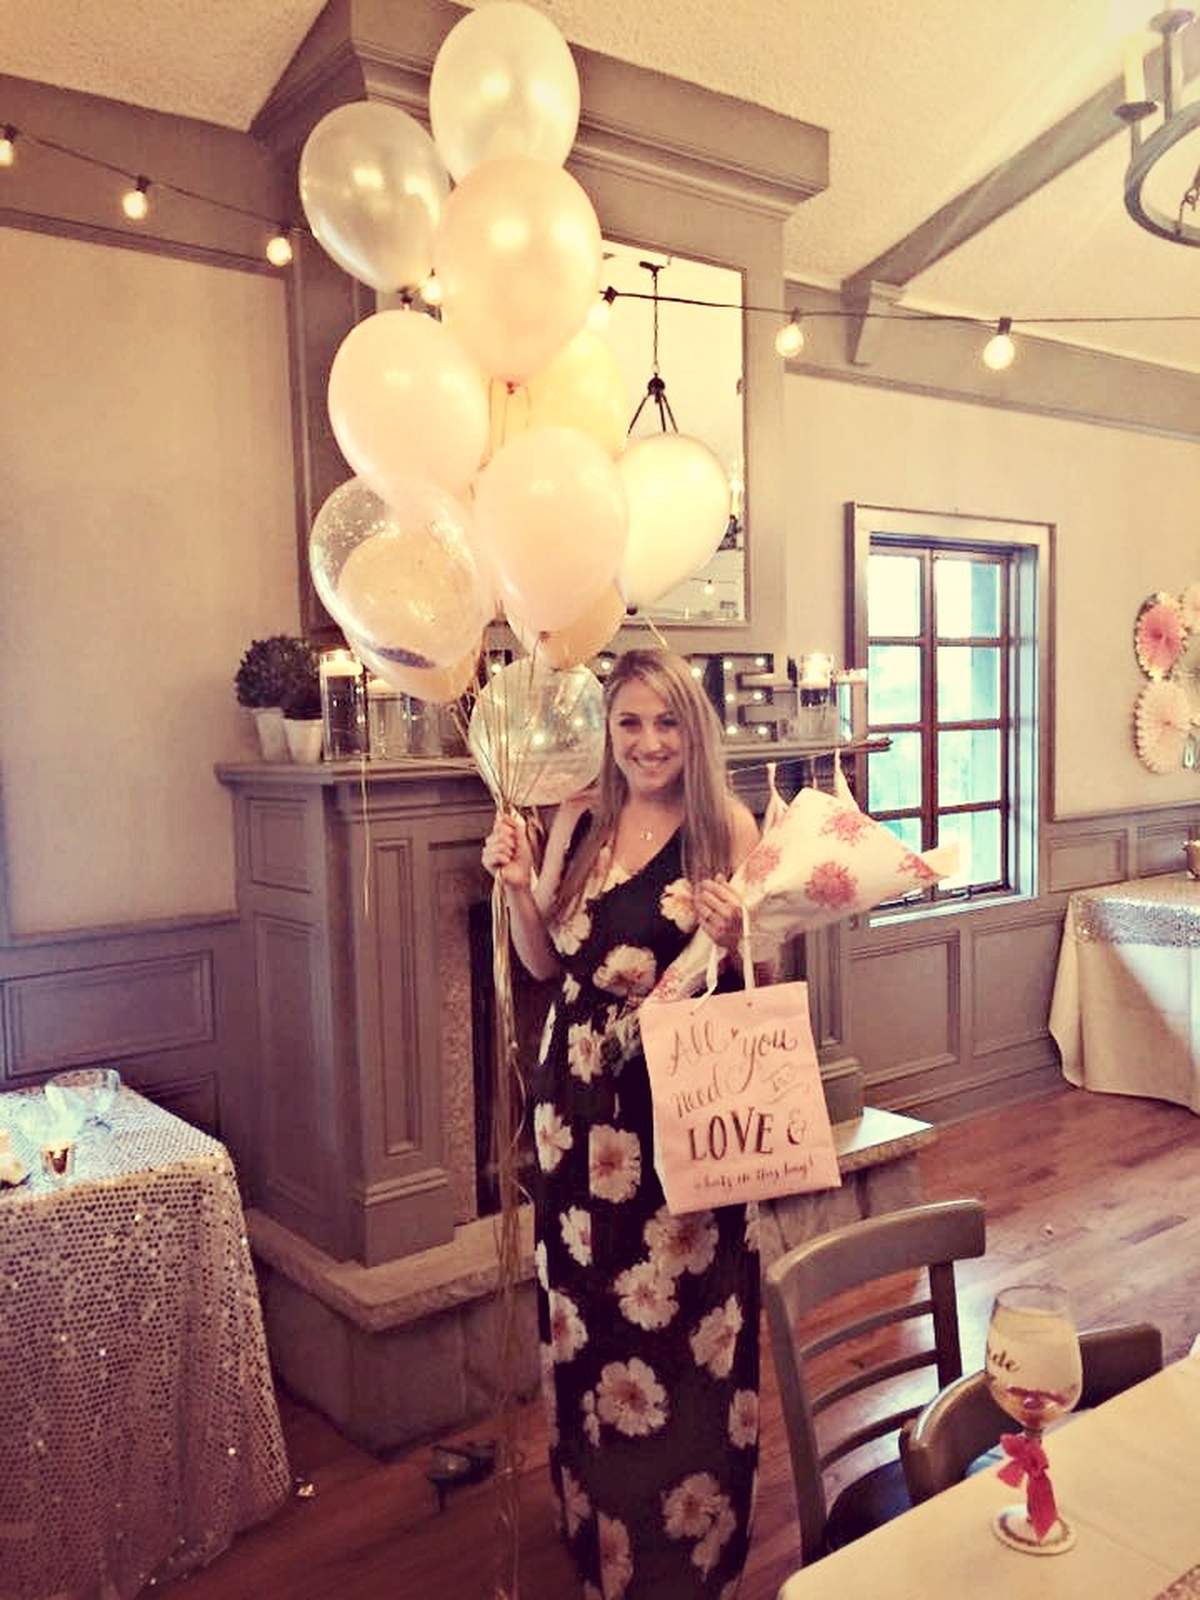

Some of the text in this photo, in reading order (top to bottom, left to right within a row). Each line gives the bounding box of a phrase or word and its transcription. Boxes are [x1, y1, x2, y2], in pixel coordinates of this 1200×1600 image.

[669, 1019, 799, 1094] All you
[671, 1064, 726, 1118] need
[688, 1107, 774, 1161] LOVE
